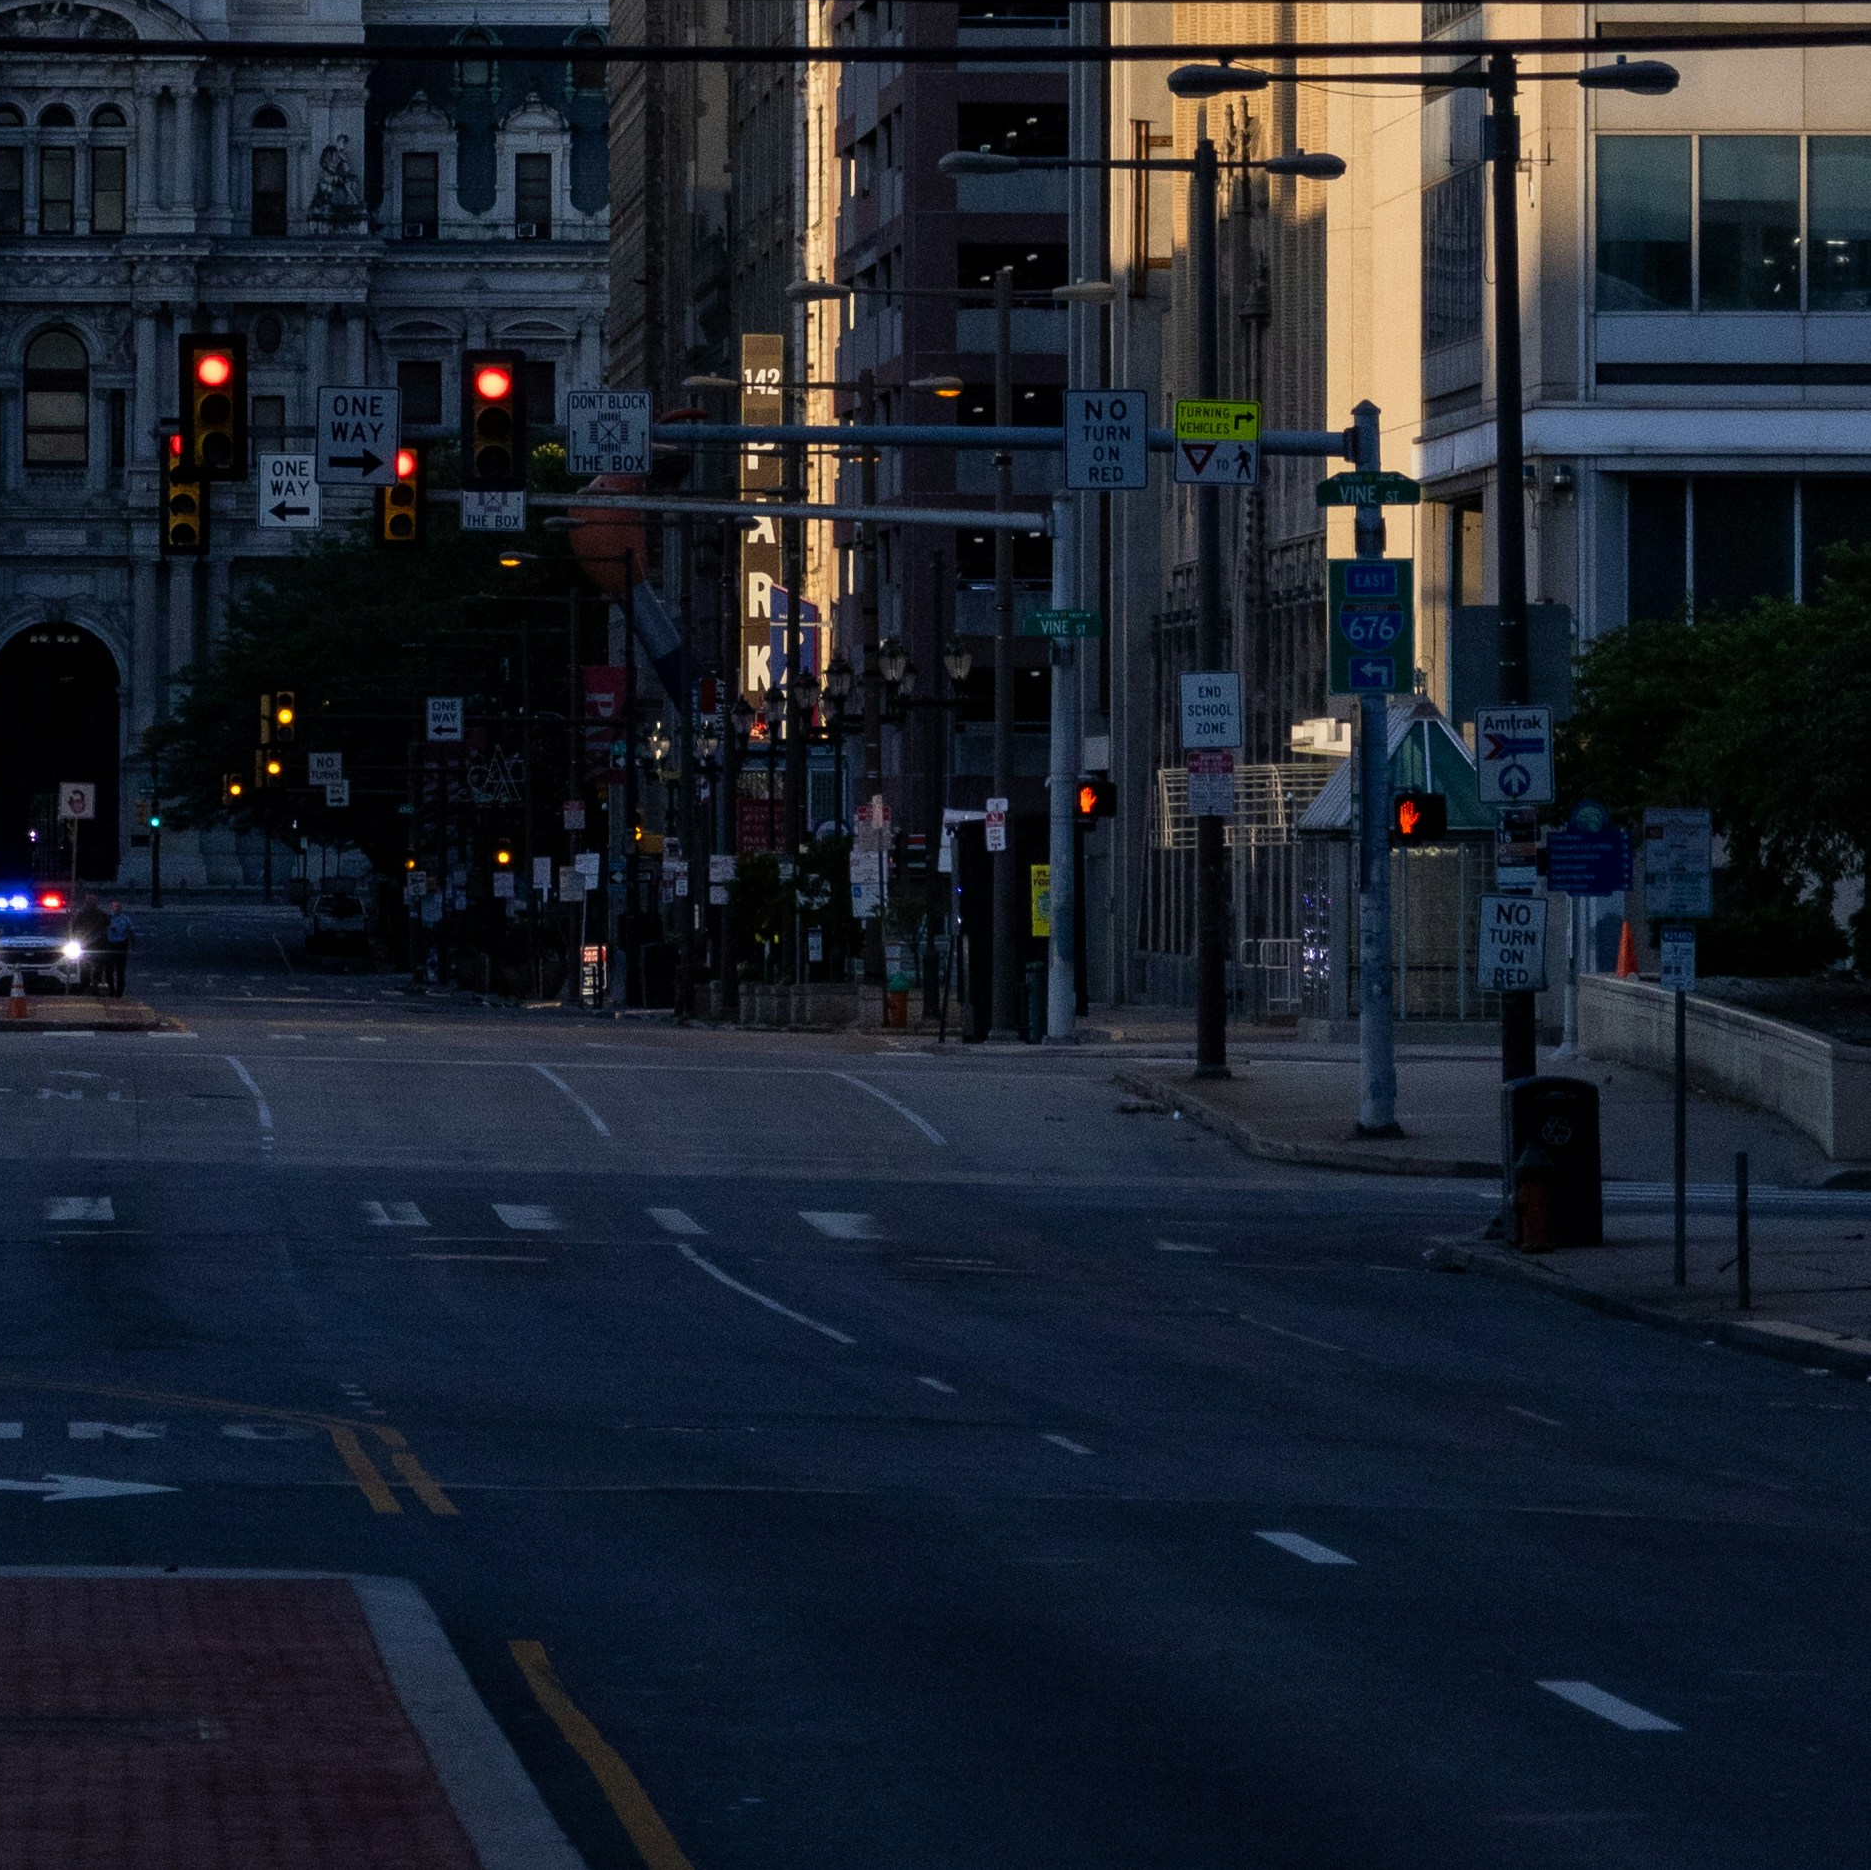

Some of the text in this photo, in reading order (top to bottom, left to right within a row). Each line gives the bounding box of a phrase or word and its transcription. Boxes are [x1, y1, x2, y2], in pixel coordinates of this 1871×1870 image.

[744, 368, 781, 395] 142
[333, 395, 383, 417] ONE
[608, 395, 647, 410] BLOCK
[1085, 399, 1127, 421] NO
[1180, 406, 1230, 419] TURNING
[331, 421, 384, 443] WAY
[1083, 426, 1131, 441] TURN
[1180, 421, 1230, 434] VEHICLES
[1093, 446, 1120, 462] ON
[271, 460, 309, 477] ONE
[574, 455, 645, 472] THE BOX
[1216, 458, 1230, 471] TO
[1088, 466, 1125, 482] RED
[270, 480, 310, 496] WAY
[1338, 485, 1400, 504] VINE ST
[466, 515, 521, 527] THE BOX
[1354, 573, 1387, 588] EAST
[1040, 619, 1070, 635] VINE
[1348, 615, 1395, 641] 676
[1198, 686, 1222, 699] END
[431, 701, 458, 710] ONE
[1187, 703, 1234, 717] SCHOOL
[431, 713, 458, 722] WAY
[1484, 714, 1542, 730] Amtrak
[1195, 722, 1227, 735] ZONE
[316, 756, 335, 768] NO
[1496, 903, 1531, 925] NO
[1489, 928, 1536, 946] TURN
[1499, 948, 1524, 965] ON
[1493, 968, 1529, 985] RED
